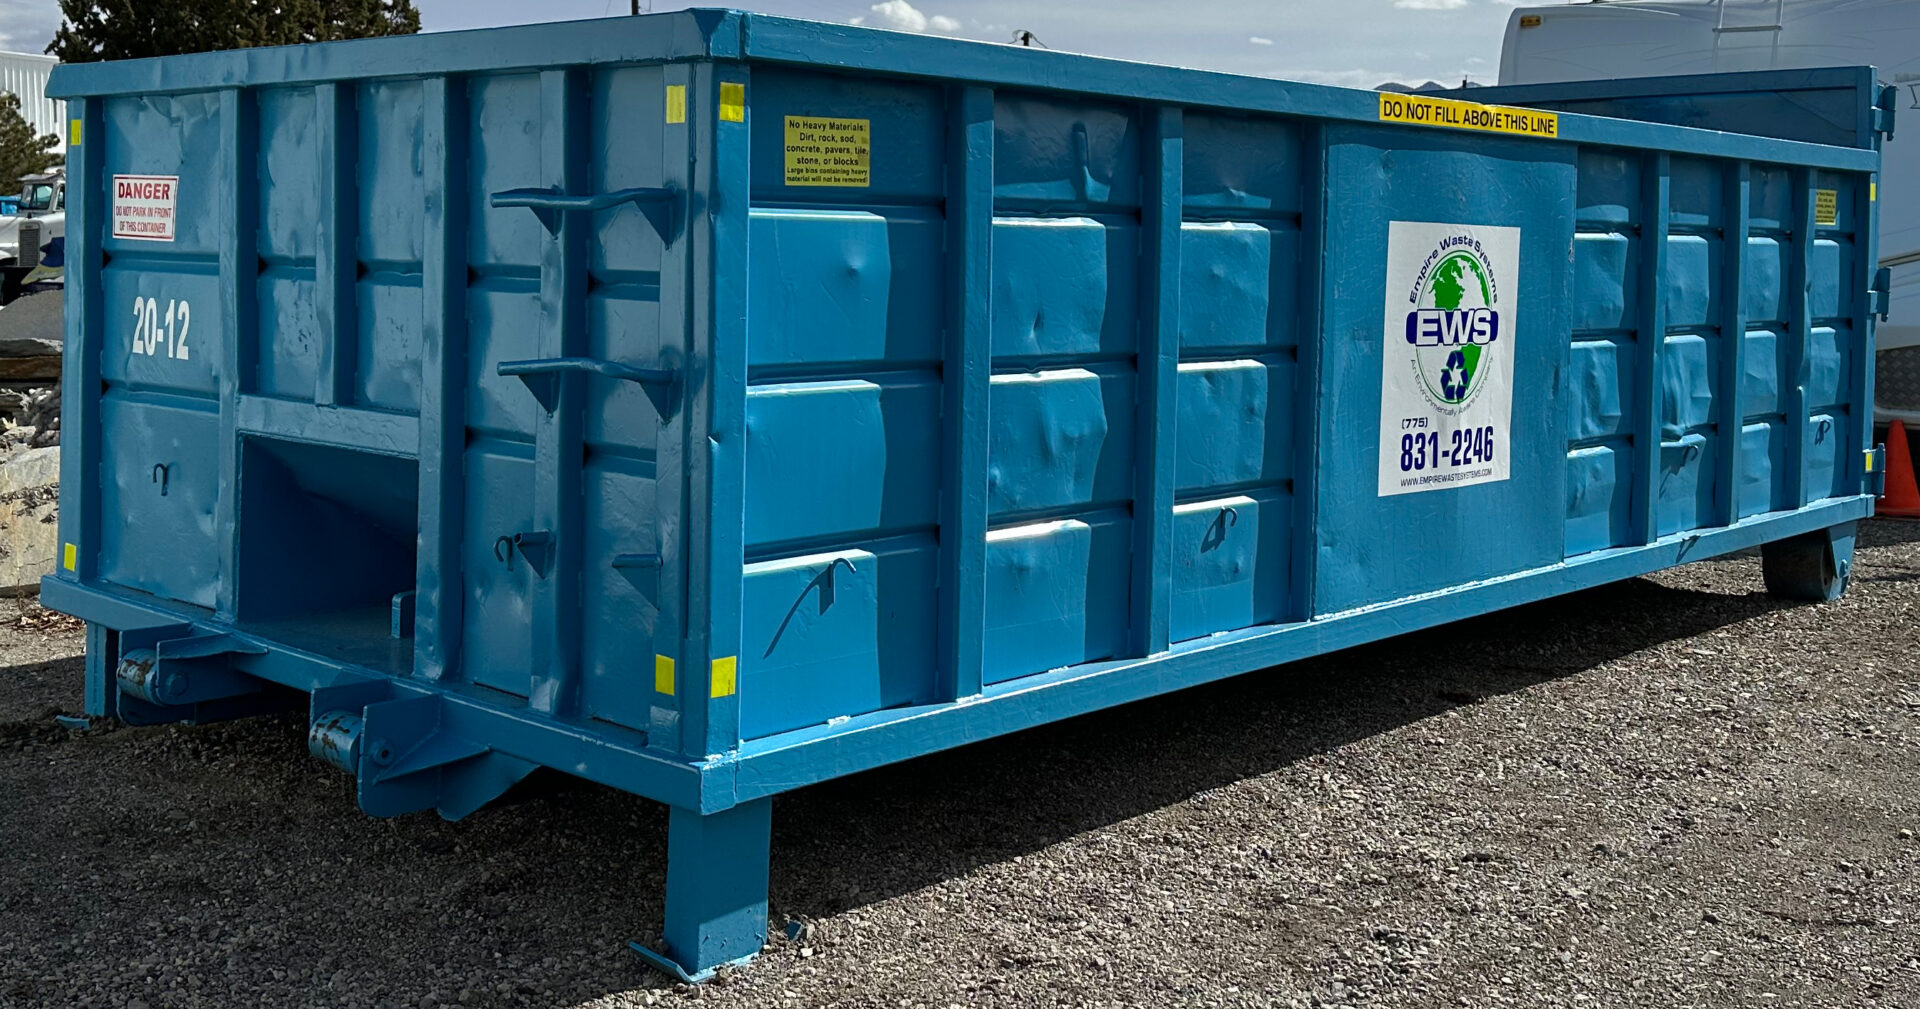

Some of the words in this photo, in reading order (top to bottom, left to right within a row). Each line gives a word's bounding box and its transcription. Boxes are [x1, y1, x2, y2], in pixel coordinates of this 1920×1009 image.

[1383, 100, 1402, 118] DO
[1406, 102, 1431, 121] NOT
[1435, 106, 1459, 124] FILL
[1463, 109, 1502, 128] ABOVE
[1504, 113, 1528, 131] THIS
[1531, 116, 1555, 134] LINE
[789, 119, 800, 129] No
[803, 120, 826, 131] Heavy
[829, 121, 866, 132] Materials:
[799, 133, 816, 142] Dirt,
[818, 134, 838, 143] rock,
[840, 135, 856, 144] sod,
[786, 145, 823, 153] concrete,
[825, 147, 852, 155] pavers,
[855, 147, 869, 155] tile,
[796, 156, 821, 166] stone,
[833, 157, 859, 166] blocks
[787, 167, 804, 175] Large
[820, 168, 850, 176] containing
[118, 182, 170, 200] DANGER
[115, 205, 122, 216] DO
[123, 206, 132, 217] NOT
[133, 206, 146, 217] PARK
[147, 206, 154, 218] IN
[154, 207, 172, 218] FRONT
[120, 220, 125, 231] OF
[126, 221, 136, 232] THIS
[137, 221, 166, 233] CONTAINER
[1409, 249, 1439, 304] Empire
[1439, 235, 1474, 251] Waste
[1474, 241, 1498, 304] Systems
[132, 296, 190, 361] 20-12
[1415, 307, 1492, 347] EWS
[1414, 374, 1457, 417] Environmentally
[1401, 417, 1428, 430] (775)
[1400, 425, 1494, 471] 831-2246
[1400, 468, 1492, 487] WWW.EMPIREWASTESYSTEMS.COM
